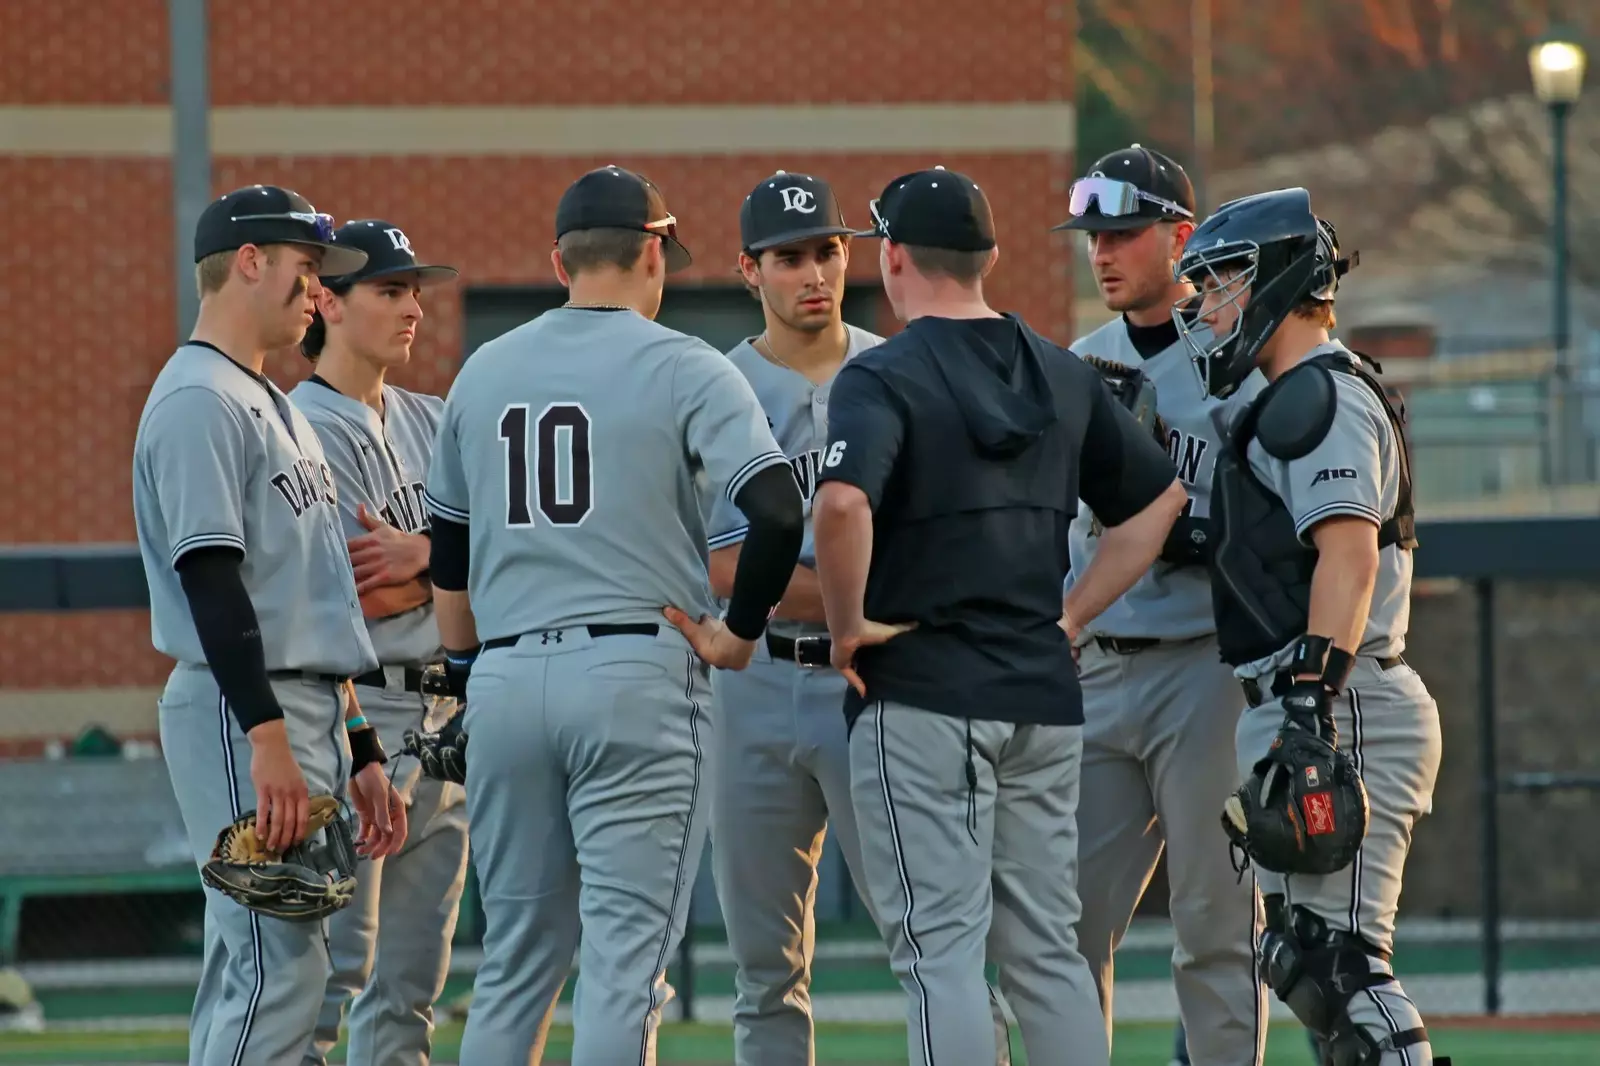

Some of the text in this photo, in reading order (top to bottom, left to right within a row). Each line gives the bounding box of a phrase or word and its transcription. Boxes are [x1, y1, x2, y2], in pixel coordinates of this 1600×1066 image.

[779, 186, 817, 214] DC
[497, 401, 594, 529] 10
[1310, 468, 1358, 488] A10
